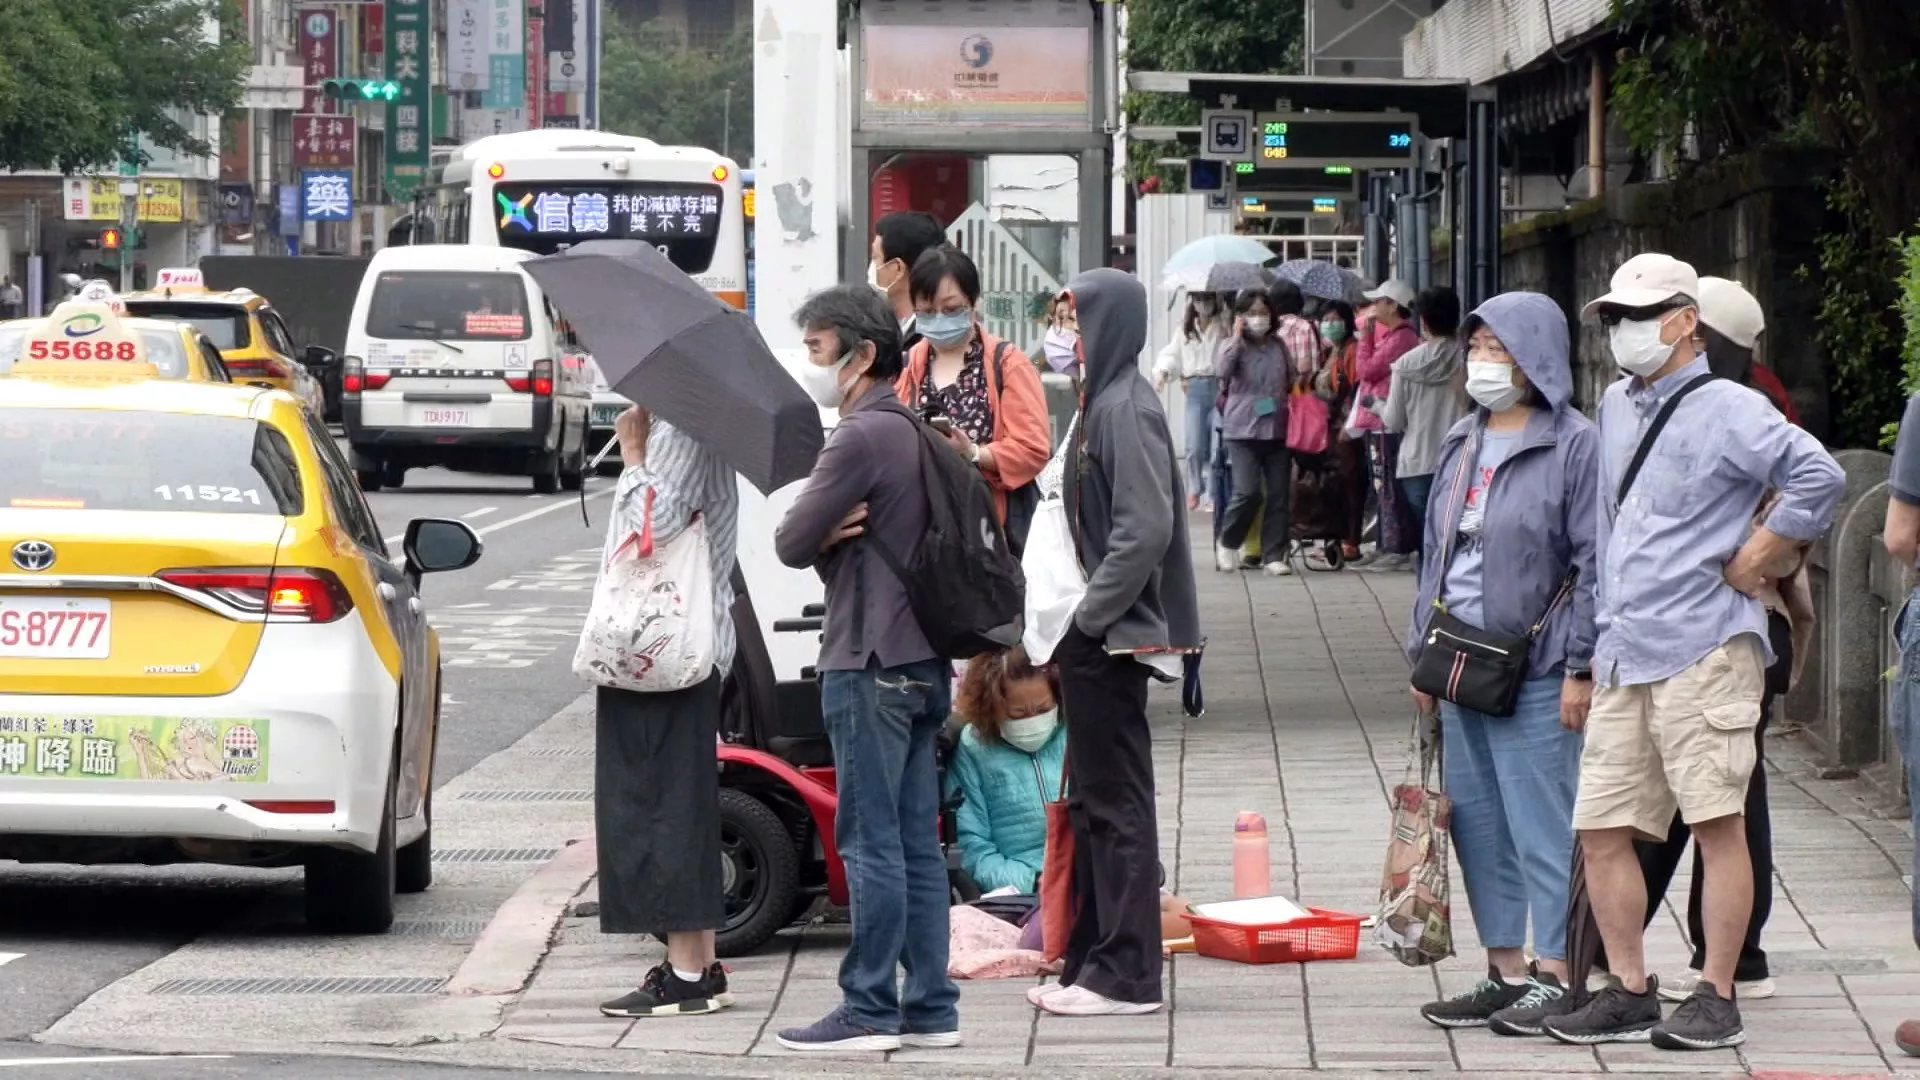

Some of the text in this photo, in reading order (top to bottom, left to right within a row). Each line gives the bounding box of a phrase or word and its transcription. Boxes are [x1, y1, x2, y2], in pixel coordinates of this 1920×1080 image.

[1264, 123, 1287, 134] 249
[1264, 135, 1286, 146] 251
[307, 175, 349, 216] 藥
[613, 195, 717, 214] 我的減碳存摺
[534, 192, 609, 233] 信義
[30, 341, 136, 360] 55688
[154, 484, 262, 505] 11521
